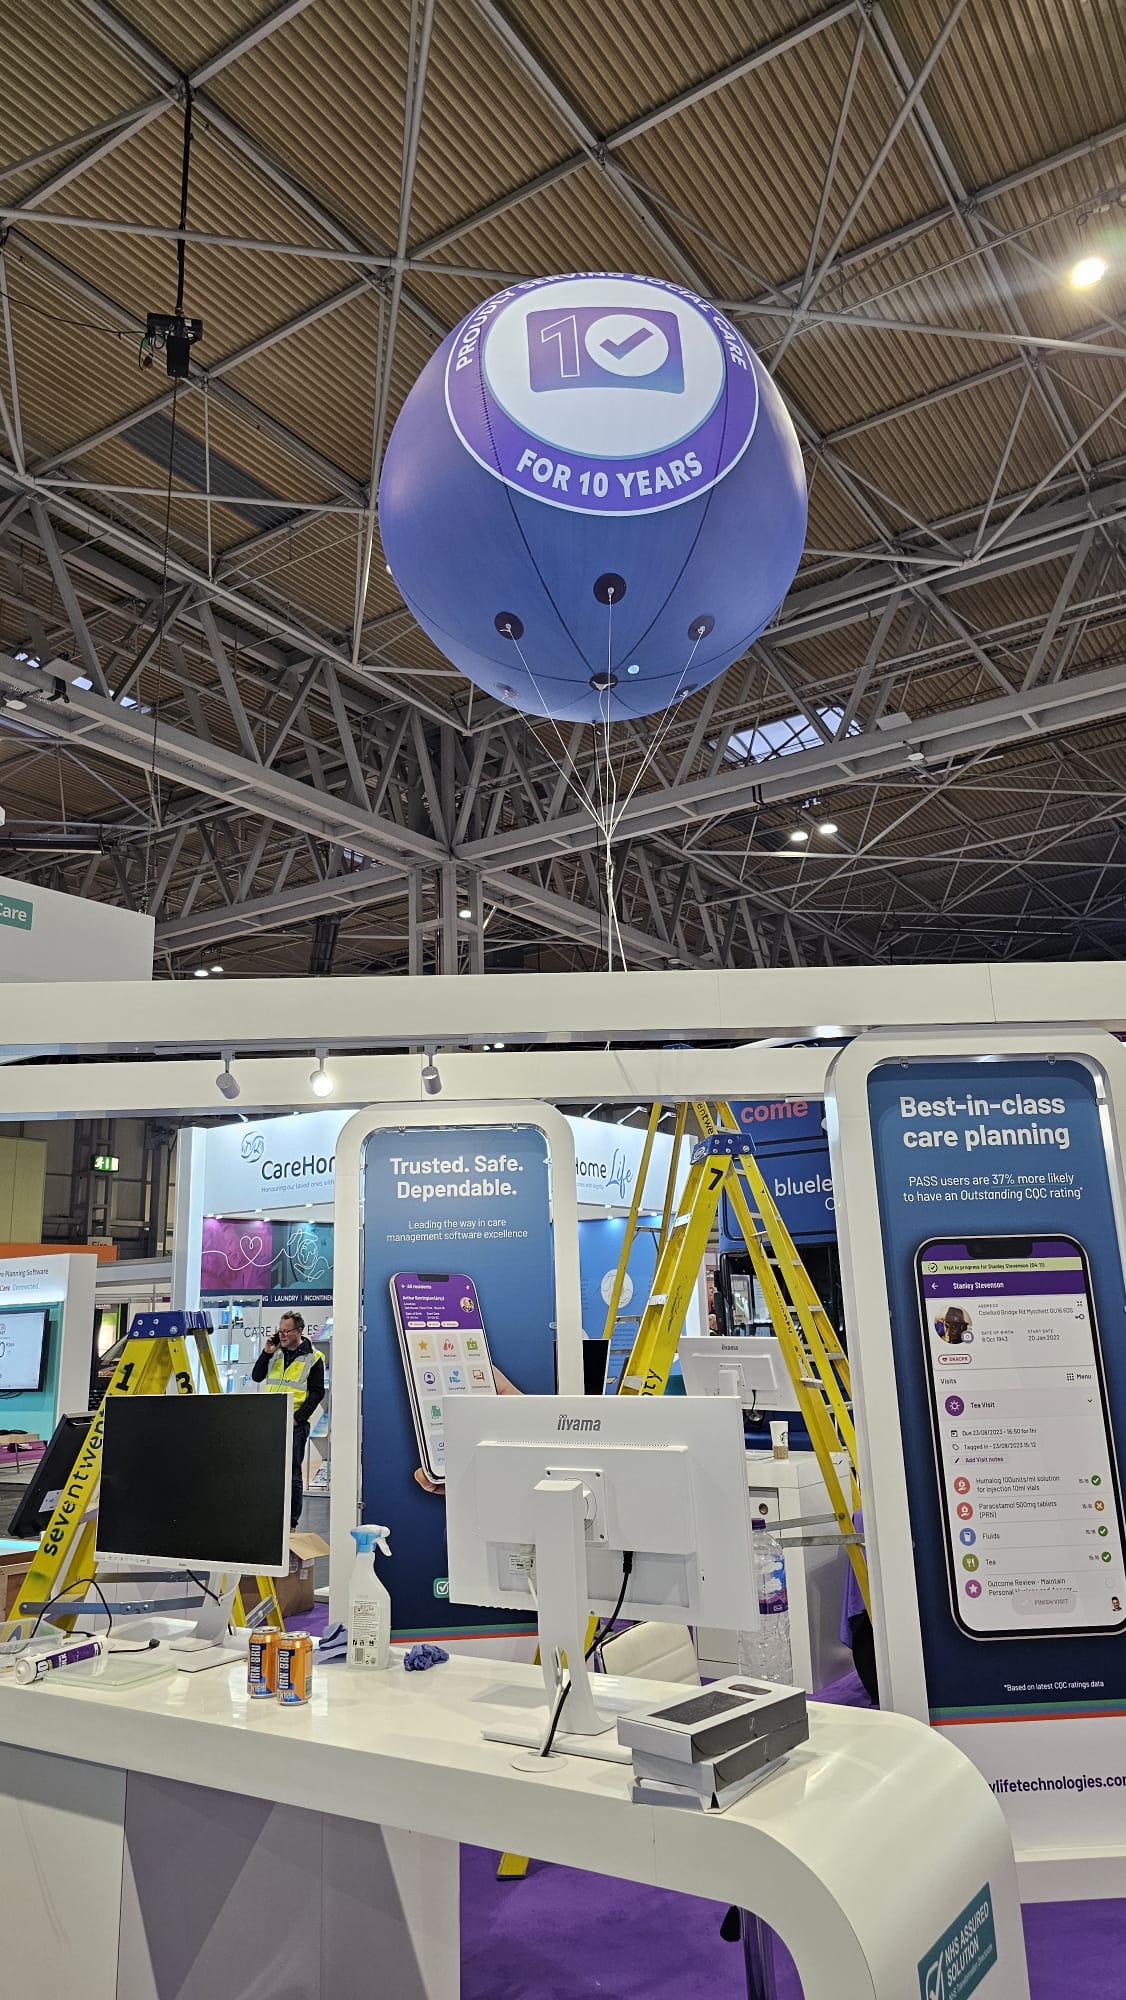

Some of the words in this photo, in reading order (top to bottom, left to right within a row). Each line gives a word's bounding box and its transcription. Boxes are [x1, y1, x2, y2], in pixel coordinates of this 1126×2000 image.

[456, 289, 517, 372] PROUDLY
[632, 275, 711, 313] SOCIAL
[713, 316, 748, 371] CARE
[516, 449, 572, 492] FOR
[579, 471, 608, 498] 10
[616, 452, 703, 498] YEARS
[740, 1100, 809, 1124] come
[900, 1094, 1066, 1118] Best-in-class
[903, 1129, 958, 1148] care
[965, 1123, 1071, 1151] planning
[389, 1157, 470, 1175] Trusted.
[474, 1155, 524, 1173] Safe.
[606, 1148, 634, 1200] Life
[708, 1167, 724, 1191] 7
[909, 1176, 938, 1187] PASS
[941, 1177, 970, 1186] users
[972, 1177, 990, 1185] are
[992, 1174, 1015, 1185] 37%
[1017, 1175, 1045, 1184] more
[1048, 1173, 1074, 1185] likely
[397, 1179, 517, 1202] Dependable.
[903, 1193, 914, 1202] to
[916, 1191, 942, 1202] have
[944, 1192, 958, 1201] an
[960, 1190, 1023, 1202] Outstanding
[1024, 1188, 1047, 1201] CQC
[409, 1220, 442, 1230] Leading
[443, 1219, 458, 1229] the
[459, 1220, 476, 1230] way
[478, 1219, 486, 1227] in
[487, 1219, 506, 1227] care
[387, 1232, 442, 1243] management
[444, 1231, 481, 1240] software
[483, 1230, 528, 1239] excellence
[5, 1269, 26, 1279] Planning
[27, 1268, 49, 1276] Software
[953, 1281, 974, 1291] Stanley
[974, 1281, 1005, 1289] Stevenson
[243, 1326, 271, 1338] CARE
[115, 1362, 135, 1392] 1
[557, 1414, 602, 1432] iiyama
[986, 1485, 1011, 1494] injection
[1012, 1484, 1026, 1492] 10ml
[979, 1502, 1015, 1510] Paracetamol
[1016, 1502, 1036, 1510] 500mg
[982, 1532, 1000, 1540] Fluids
[987, 1580, 1014, 1588] Outcome
[1041, 1577, 1066, 1585] Maintain
[988, 1588, 1014, 1596] Personal
[1068, 1681, 1090, 1689] ratings
[1090, 1680, 1105, 1688] data
[945, 1936, 960, 1966] NHS
[960, 1901, 989, 1948] ASSURED
[947, 1934, 980, 1987] SOLUTION
